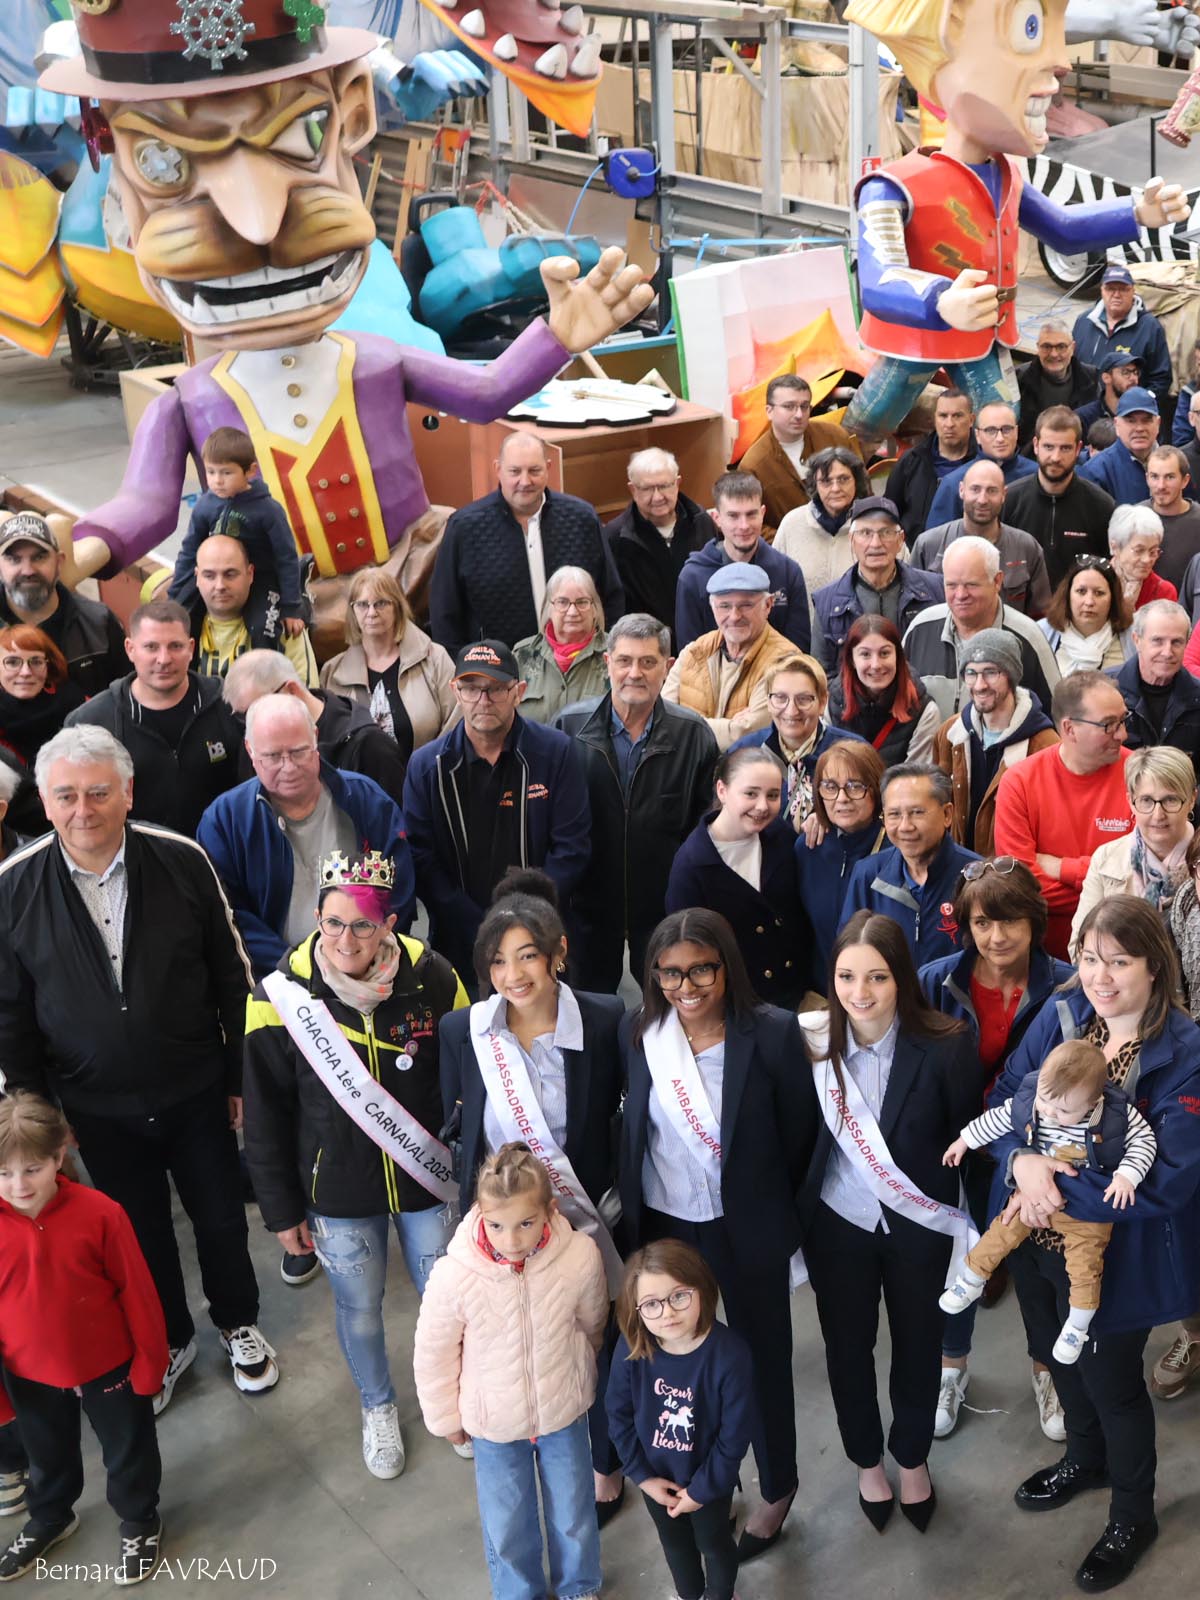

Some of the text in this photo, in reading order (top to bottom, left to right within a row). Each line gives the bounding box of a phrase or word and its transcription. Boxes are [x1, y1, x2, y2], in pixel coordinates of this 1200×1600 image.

[296, 1005, 452, 1183] CHACHA 1ère CARNAVAL 2025
[488, 1032, 576, 1199] AMBASSADRICE DE CHOLET
[671, 1079, 722, 1158] AMBASSADRI
[829, 1089, 890, 1180] AMBASSADRICE
[887, 1179, 904, 1192] DE
[663, 1394, 679, 1409] de
